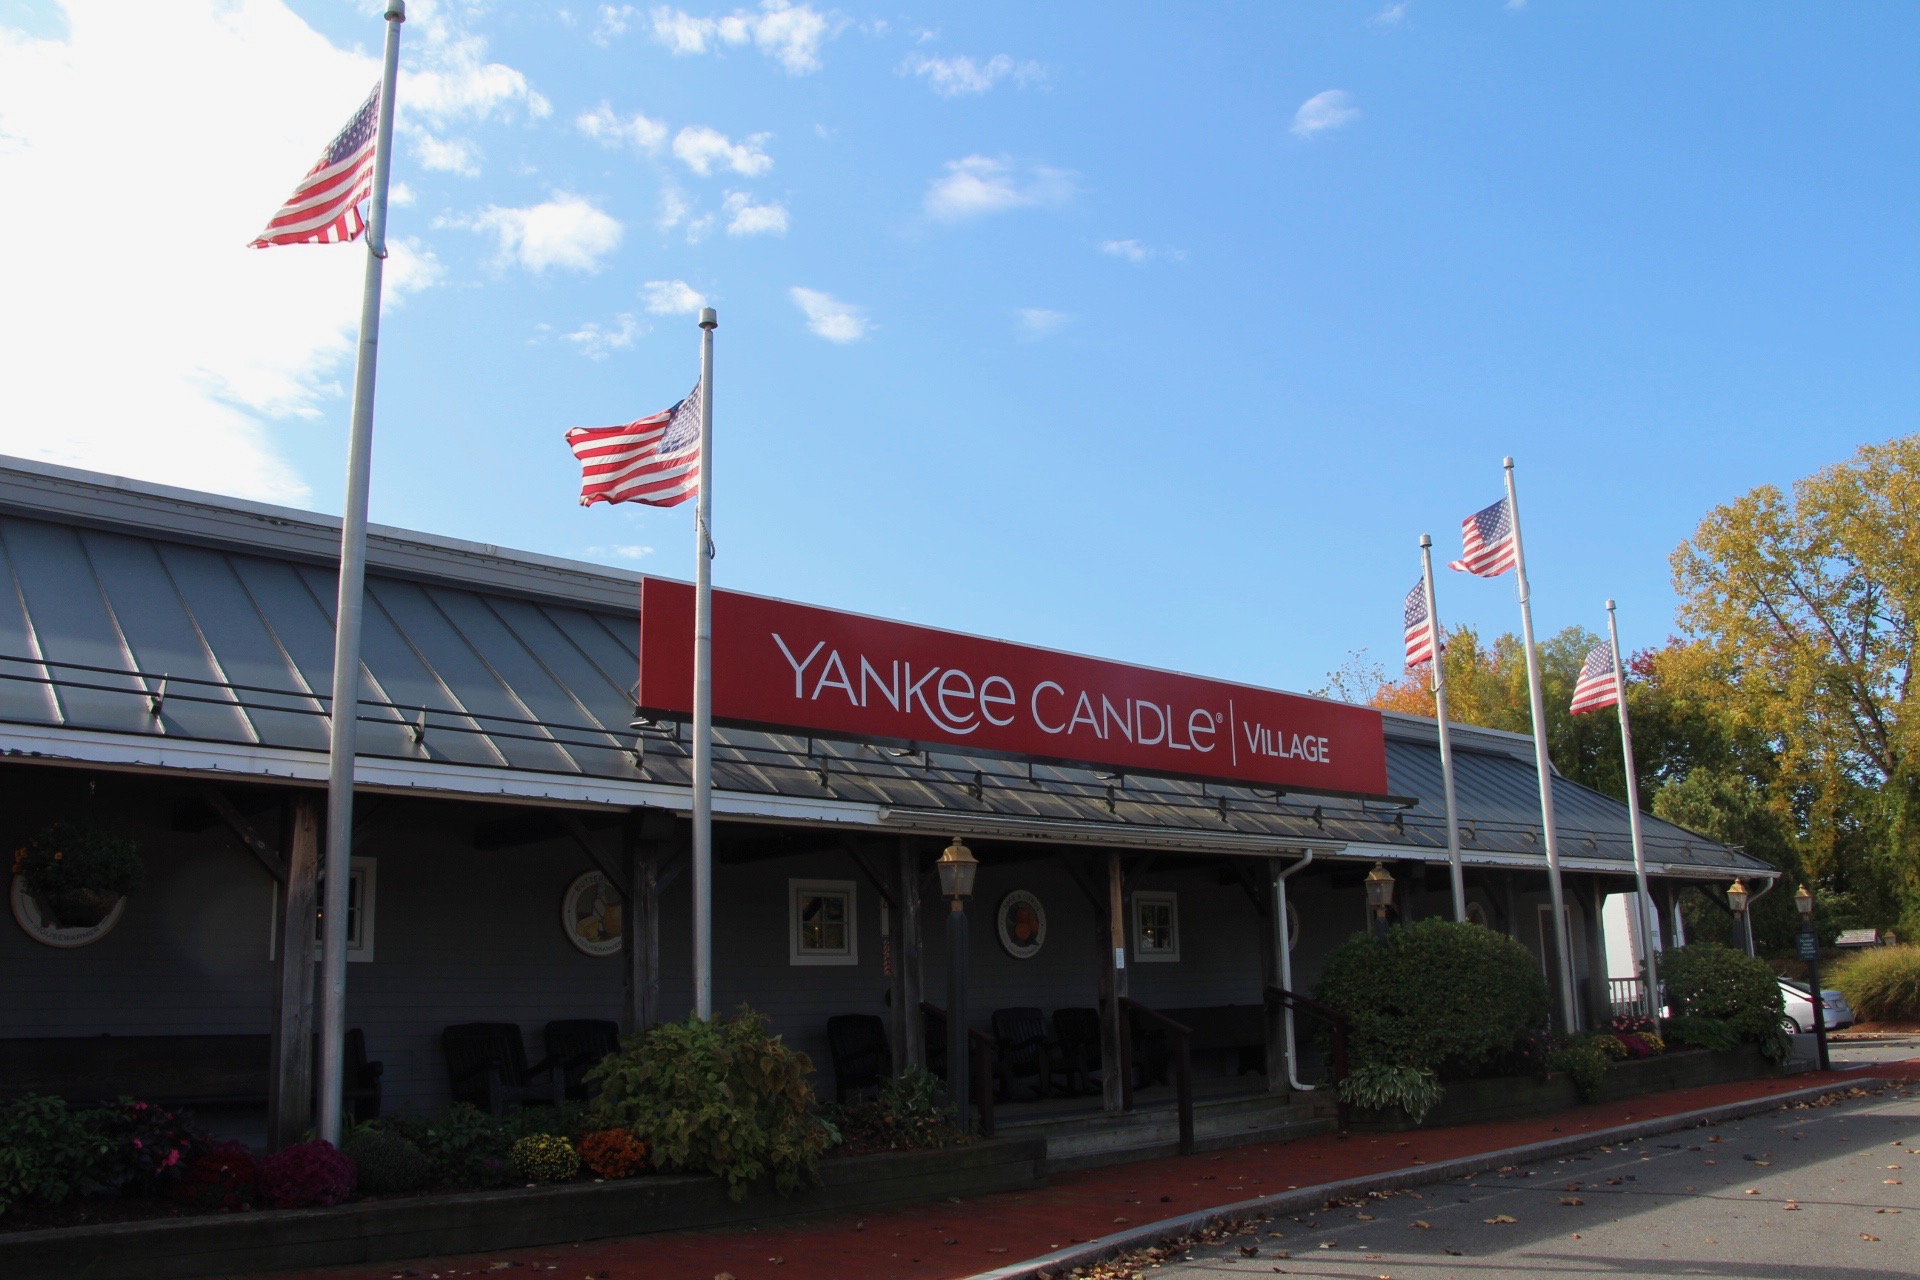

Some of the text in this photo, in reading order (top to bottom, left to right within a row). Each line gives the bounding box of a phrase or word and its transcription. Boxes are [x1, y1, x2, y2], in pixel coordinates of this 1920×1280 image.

[771, 632, 1016, 735] YANKee
[1243, 720, 1330, 764] VILLAGE
[34, 924, 101, 941] HOUSEWARMER
